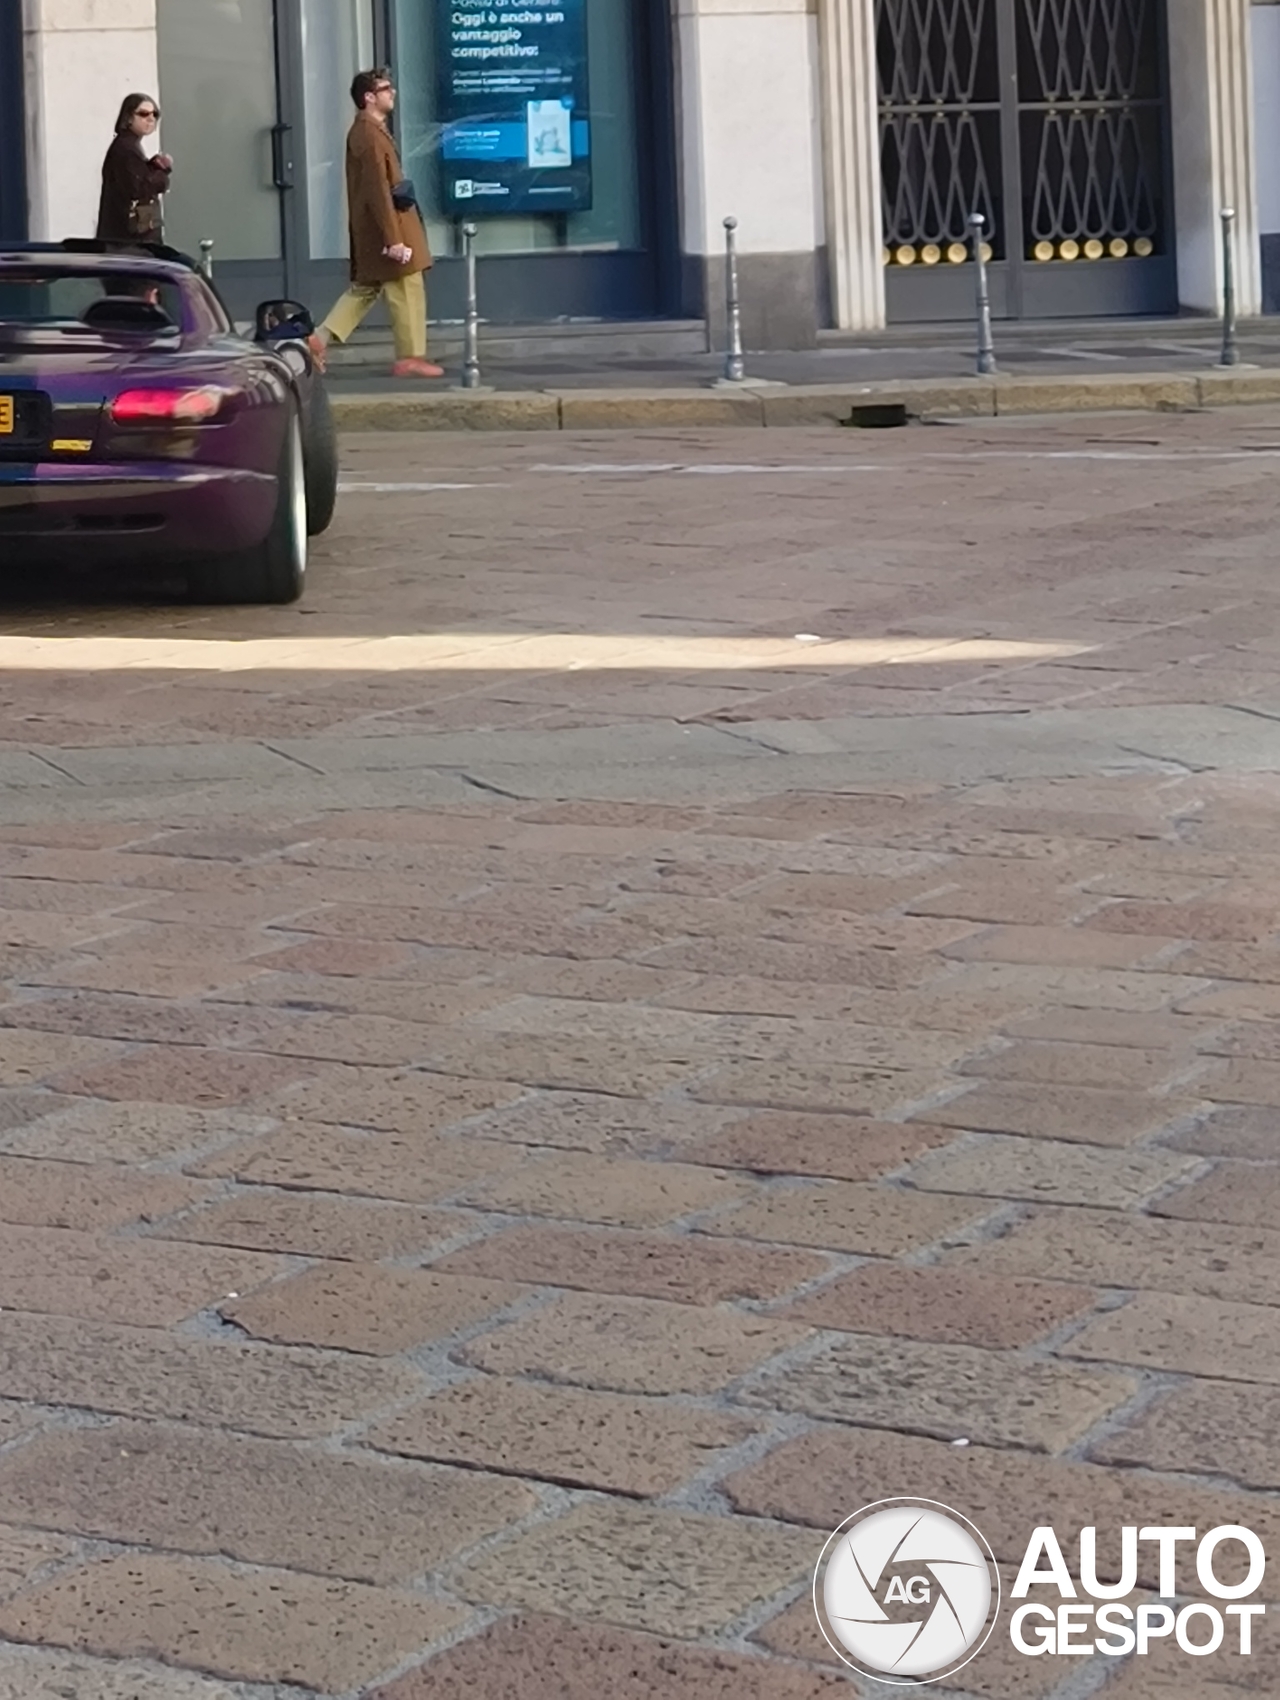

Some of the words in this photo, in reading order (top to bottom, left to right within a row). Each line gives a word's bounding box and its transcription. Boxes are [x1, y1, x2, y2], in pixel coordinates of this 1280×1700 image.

[451, 11, 486, 27] Oggi
[500, 10, 543, 24] anche
[545, 11, 565, 23] un
[451, 27, 522, 43] vantaggio
